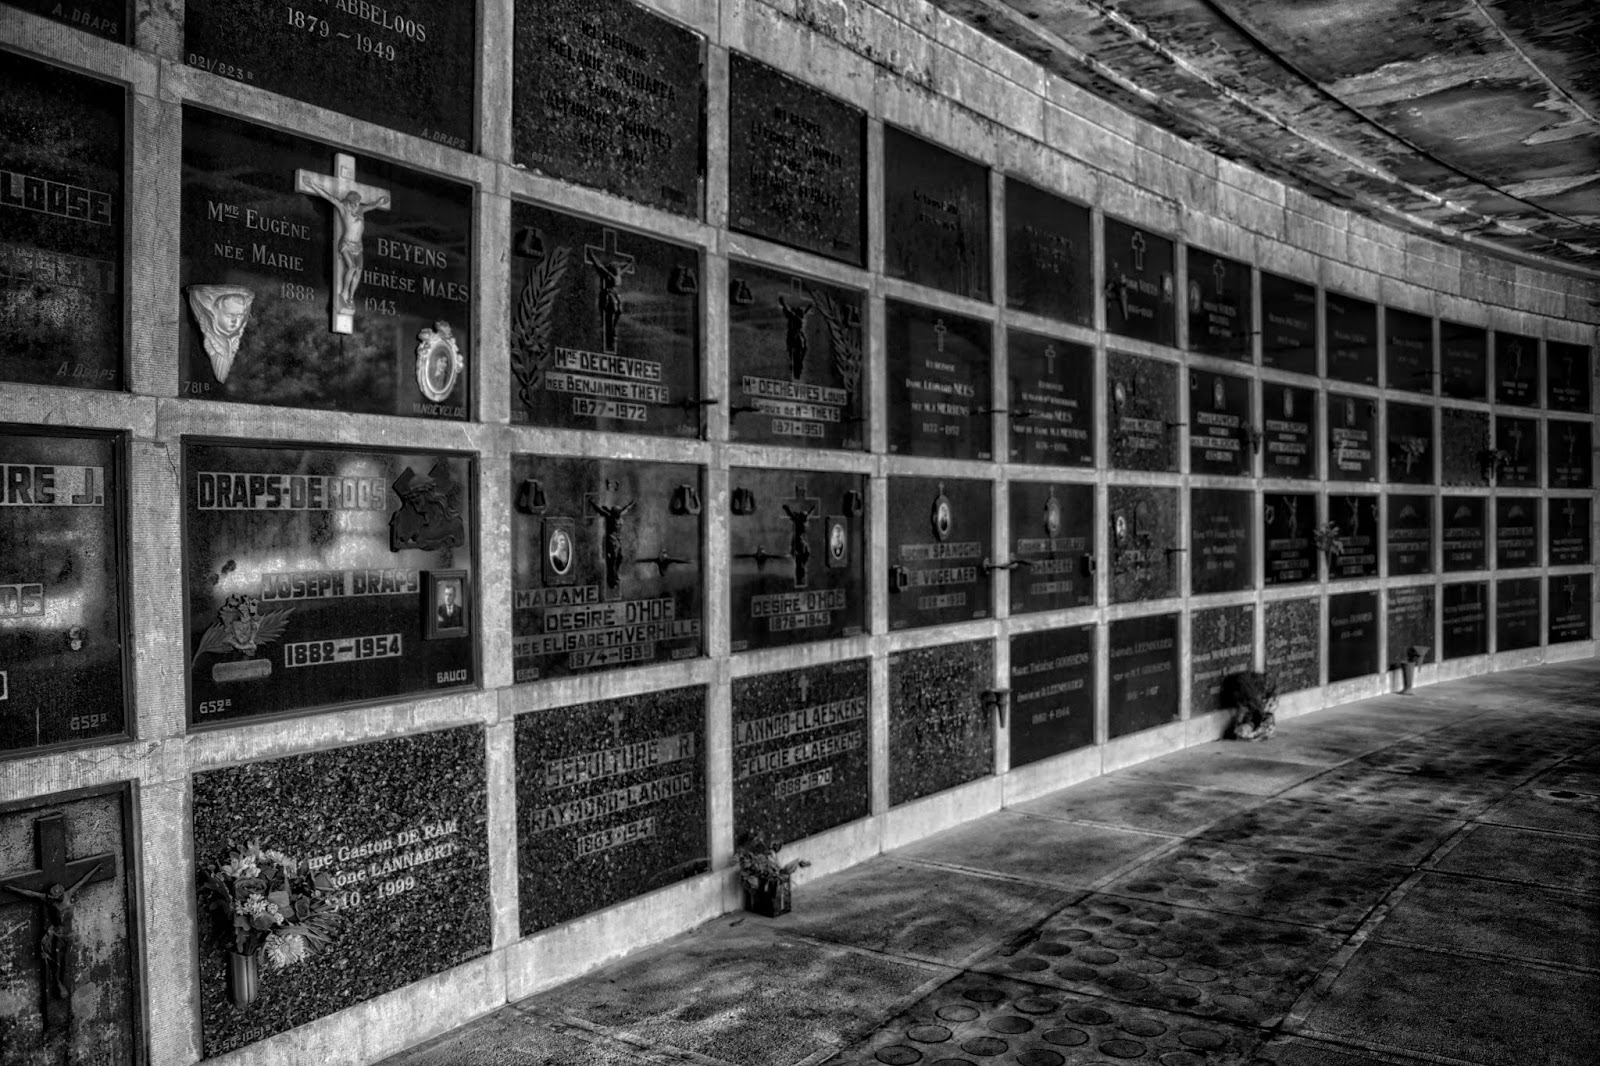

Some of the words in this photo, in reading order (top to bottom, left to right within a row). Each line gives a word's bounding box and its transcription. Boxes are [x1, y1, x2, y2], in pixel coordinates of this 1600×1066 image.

[287, 7, 330, 38] 1879
[356, 33, 395, 62] 1949
[335, 0, 426, 42] ABBELOOS
[377, 237, 448, 270] BEYENS
[280, 282, 315, 301] 1888
[422, 276, 470, 303] MAES
[263, 572, 345, 600] JOSEPH
[352, 570, 419, 596] DRAPS
[516, 587, 597, 607] MADAME
[436, 669, 467, 683] BAUCO
[338, 839, 393, 862] Gaston
[397, 829, 420, 848] DE
[423, 818, 459, 841] RAM
[376, 876, 415, 899] 1999
